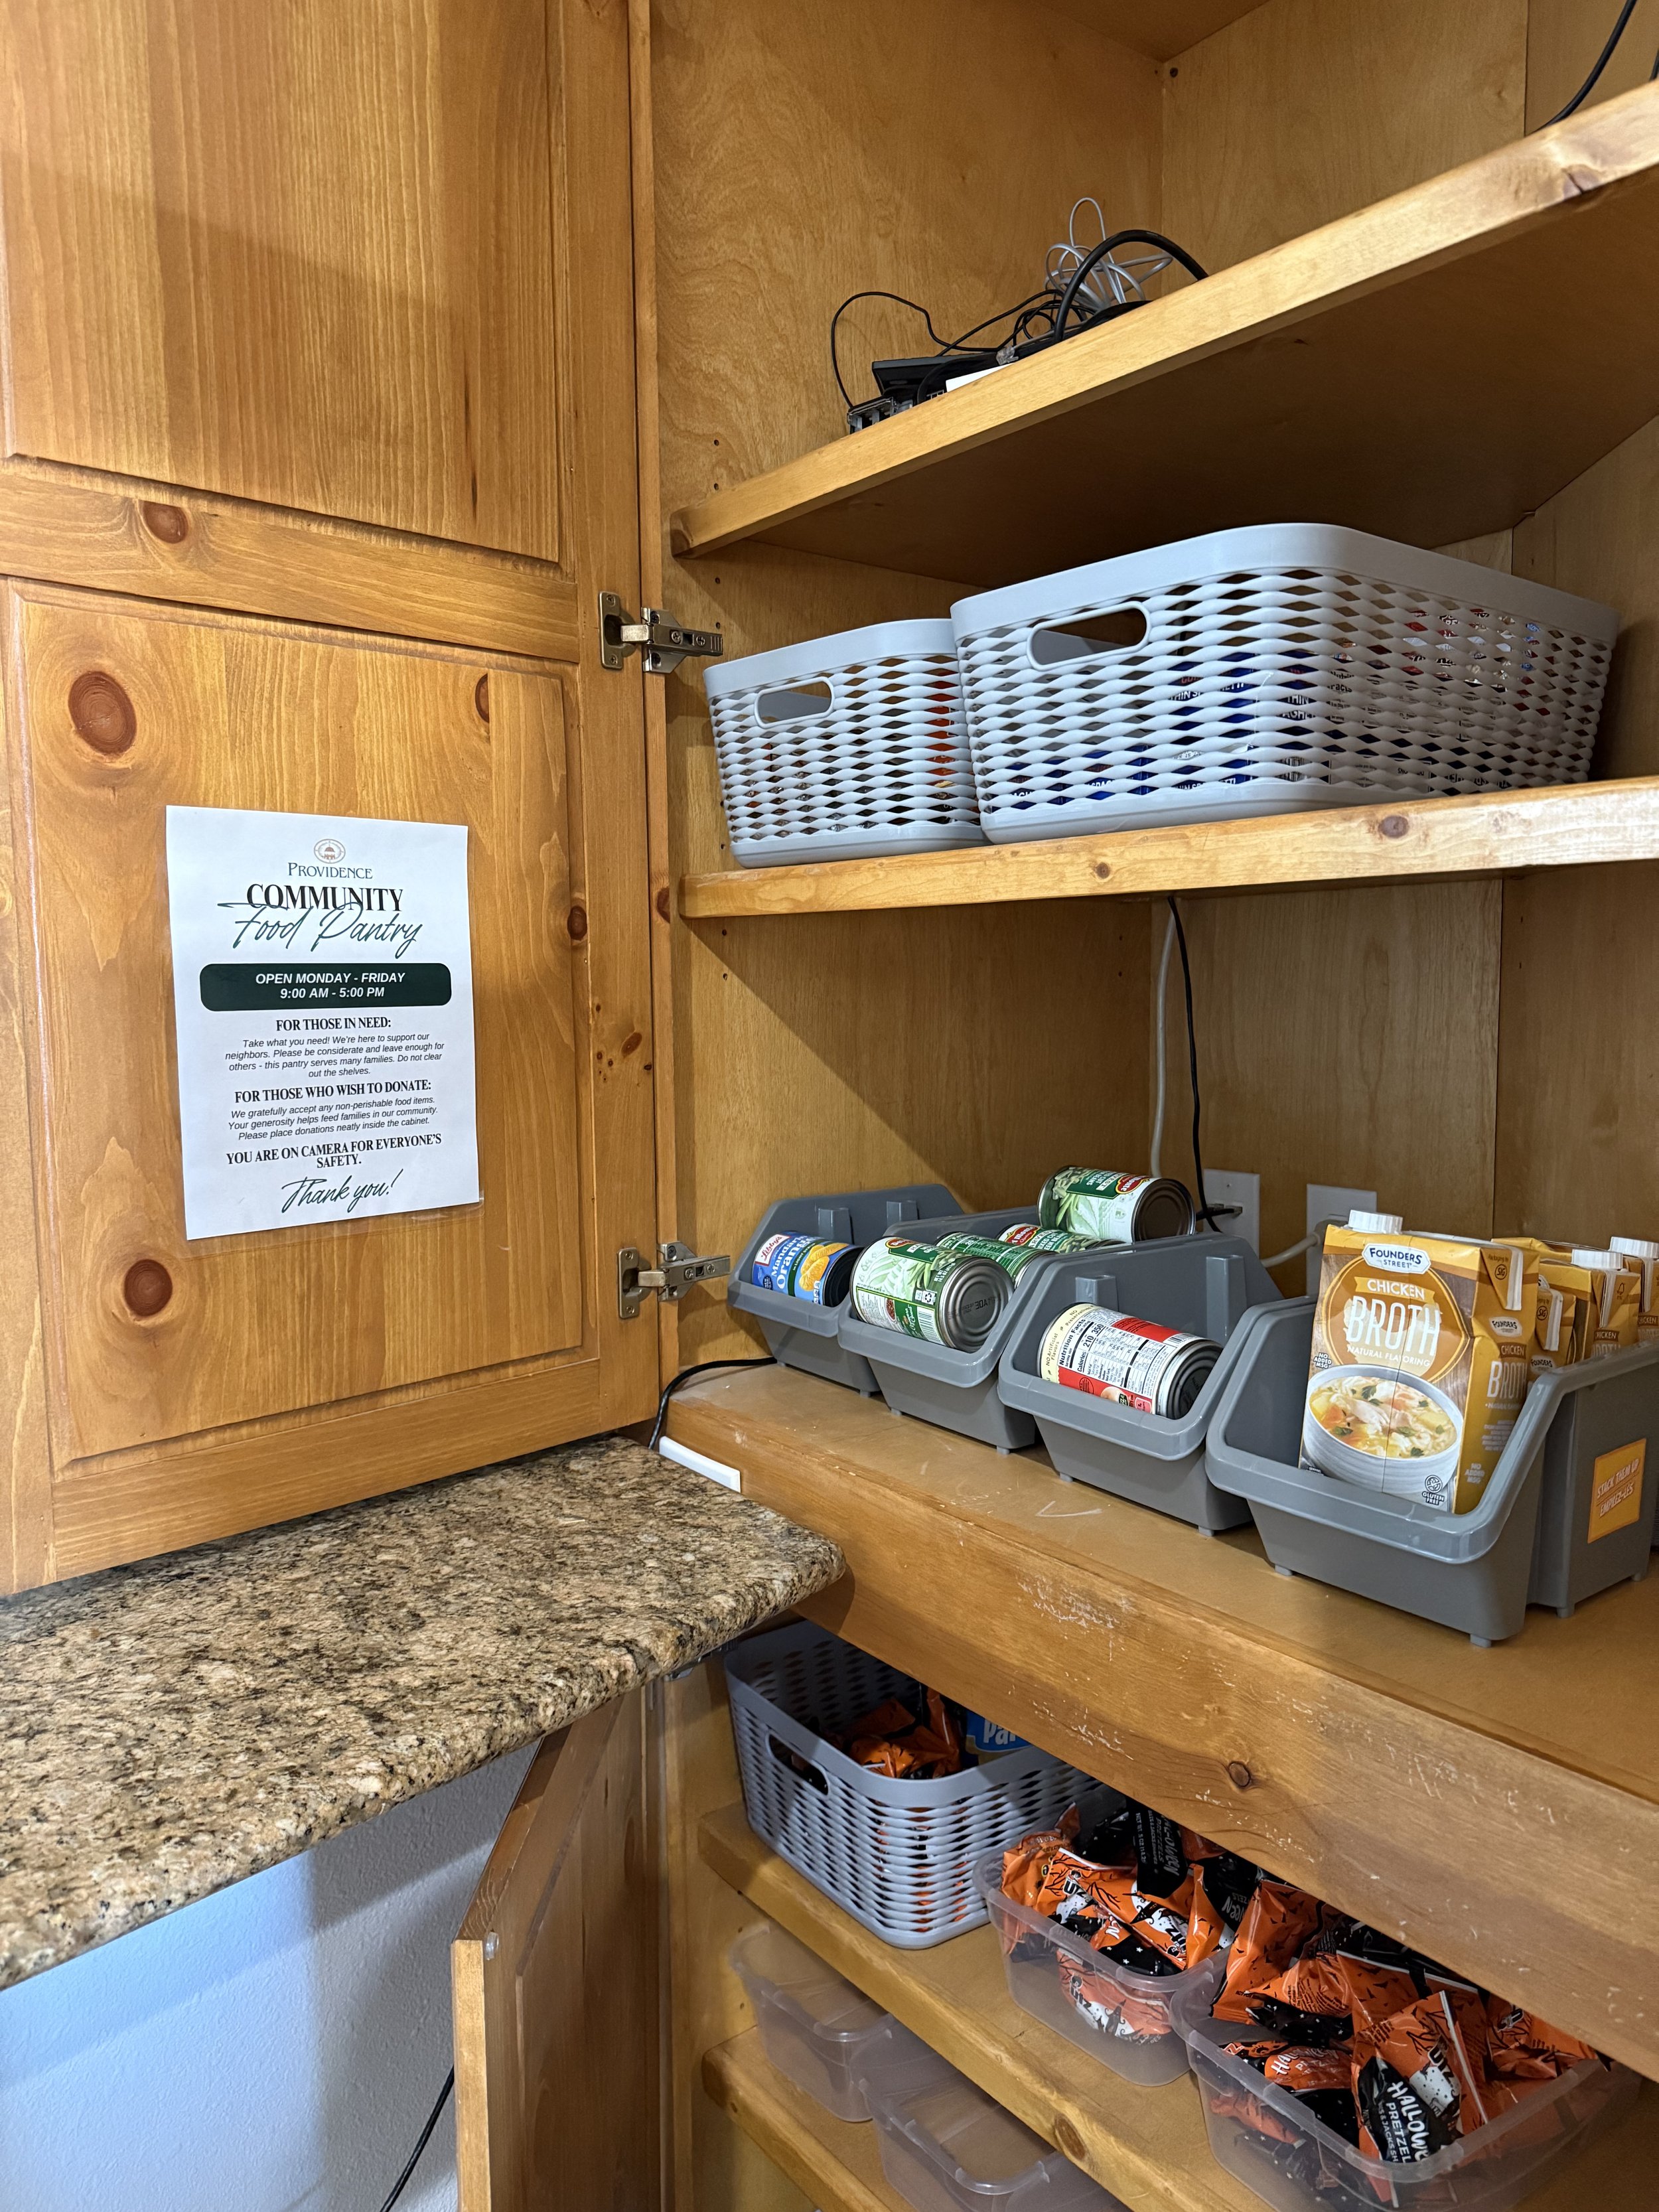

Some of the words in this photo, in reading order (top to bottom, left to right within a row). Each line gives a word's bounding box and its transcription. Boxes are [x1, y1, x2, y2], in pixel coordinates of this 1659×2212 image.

[288, 863, 373, 879] PROVIDENCE
[247, 883, 403, 911] COMMUNITY
[217, 903, 313, 949] Food
[310, 902, 423, 959] Pantry
[255, 973, 292, 984] OPEN
[296, 973, 351, 984] MONDAY
[361, 972, 405, 983] FRIDAY
[280, 988, 305, 998] 9:00
[309, 988, 328, 998] AM
[339, 987, 364, 997] 5:00
[367, 987, 385, 997] PM
[276, 1019, 301, 1031] FOR
[303, 1018, 342, 1030] THOSE
[344, 1017, 356, 1029] IN
[358, 1017, 391, 1029] NEED:
[267, 1038, 287, 1047] what
[289, 1039, 304, 1047] you
[387, 1033, 415, 1043] support
[225, 1051, 270, 1061] neighbors.
[317, 1046, 363, 1055] considerate
[405, 1043, 432, 1052] enough
[229, 1062, 256, 1071] others
[265, 1061, 279, 1069] this
[282, 1061, 309, 1070] pantry
[340, 1058, 362, 1067] many
[364, 1055, 395, 1064] families.
[338, 1067, 370, 1076] shelves.
[235, 1090, 260, 1103] FOR
[263, 1088, 303, 1101] THOSE
[305, 1085, 334, 1098] WHO
[336, 1083, 365, 1096] WISH
[367, 1082, 383, 1094] TO
[385, 1079, 431, 1092] DONATE:
[229, 1122, 249, 1130] Your
[251, 1117, 295, 1130] generosity
[297, 1116, 319, 1125] helps
[321, 1114, 338, 1122] feed
[341, 1112, 371, 1121] families
[396, 1106, 438, 1116] community.
[248, 1107, 287, 1119] gratefully
[289, 1105, 317, 1114] accept
[319, 1104, 333, 1113] any
[335, 1099, 393, 1110] non-perishable
[239, 1131, 267, 1140] Please
[270, 1129, 293, 1140] place
[295, 1125, 334, 1136] donations
[336, 1122, 360, 1132] neatly
[362, 1120, 385, 1130] inside
[401, 1117, 429, 1126] cabinet.
[226, 1151, 252, 1164] YOU
[255, 1149, 279, 1162] ARE
[281, 1147, 299, 1159] ON
[301, 1142, 349, 1157] CAMERA
[351, 1140, 374, 1152] FOR
[376, 1133, 442, 1149] EVERYONE'S
[317, 1153, 362, 1168] SAFETY.
[281, 1175, 352, 1213] Thank
[346, 1169, 403, 1213] you!
[1369, 1248, 1423, 1264] FOUNDERS
[1367, 1279, 1425, 1299] CHICKEN
[1346, 1295, 1441, 1357] BROTH
[1492, 1319, 1517, 1329] FOUNDERS
[1059, 1335, 1073, 1365] Nutrition
[1071, 1319, 1086, 1333] Facts
[1078, 1351, 1086, 1372] Calories
[1083, 1336, 1094, 1348] 210
[1092, 1324, 1104, 1334] 350
[1501, 1345, 1524, 1356] CHICKEN
[1046, 1357, 1051, 1366] NO
[1347, 1345, 1383, 1360] NATURAL
[1385, 1352, 1431, 1367] FLAVORING
[1597, 1475, 1615, 1499] STACK
[1616, 1464, 1631, 1485] THEM
[1386, 2102, 1412, 2163] PRETZEL
